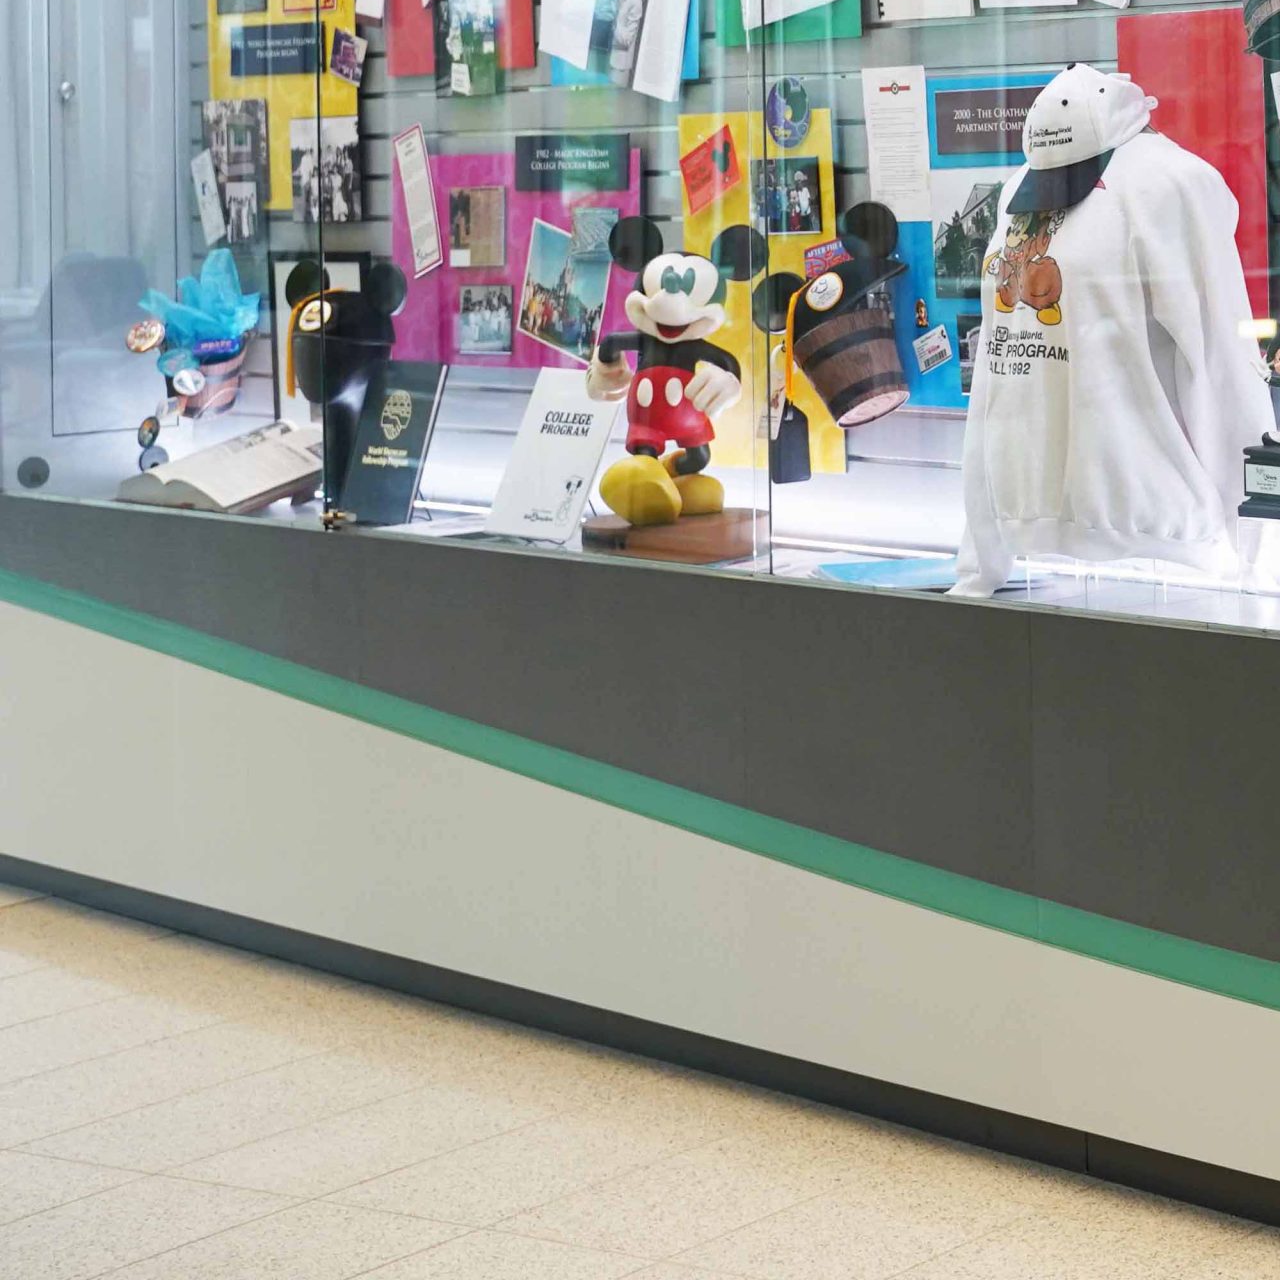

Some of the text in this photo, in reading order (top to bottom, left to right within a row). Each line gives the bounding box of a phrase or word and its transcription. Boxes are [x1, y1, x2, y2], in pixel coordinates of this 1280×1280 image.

[953, 109, 971, 120] 2000
[977, 108, 993, 119] THE
[955, 120, 1026, 133] APARTMENT COMPL
[1048, 137, 1073, 146] PROGRAM
[531, 160, 610, 170] COLLEGE PROGRAM BEGINS
[807, 246, 826, 257] AFTER
[1008, 362, 1031, 375] 1992
[544, 410, 594, 426] COLLEGE
[540, 423, 590, 437] PROGRAM
